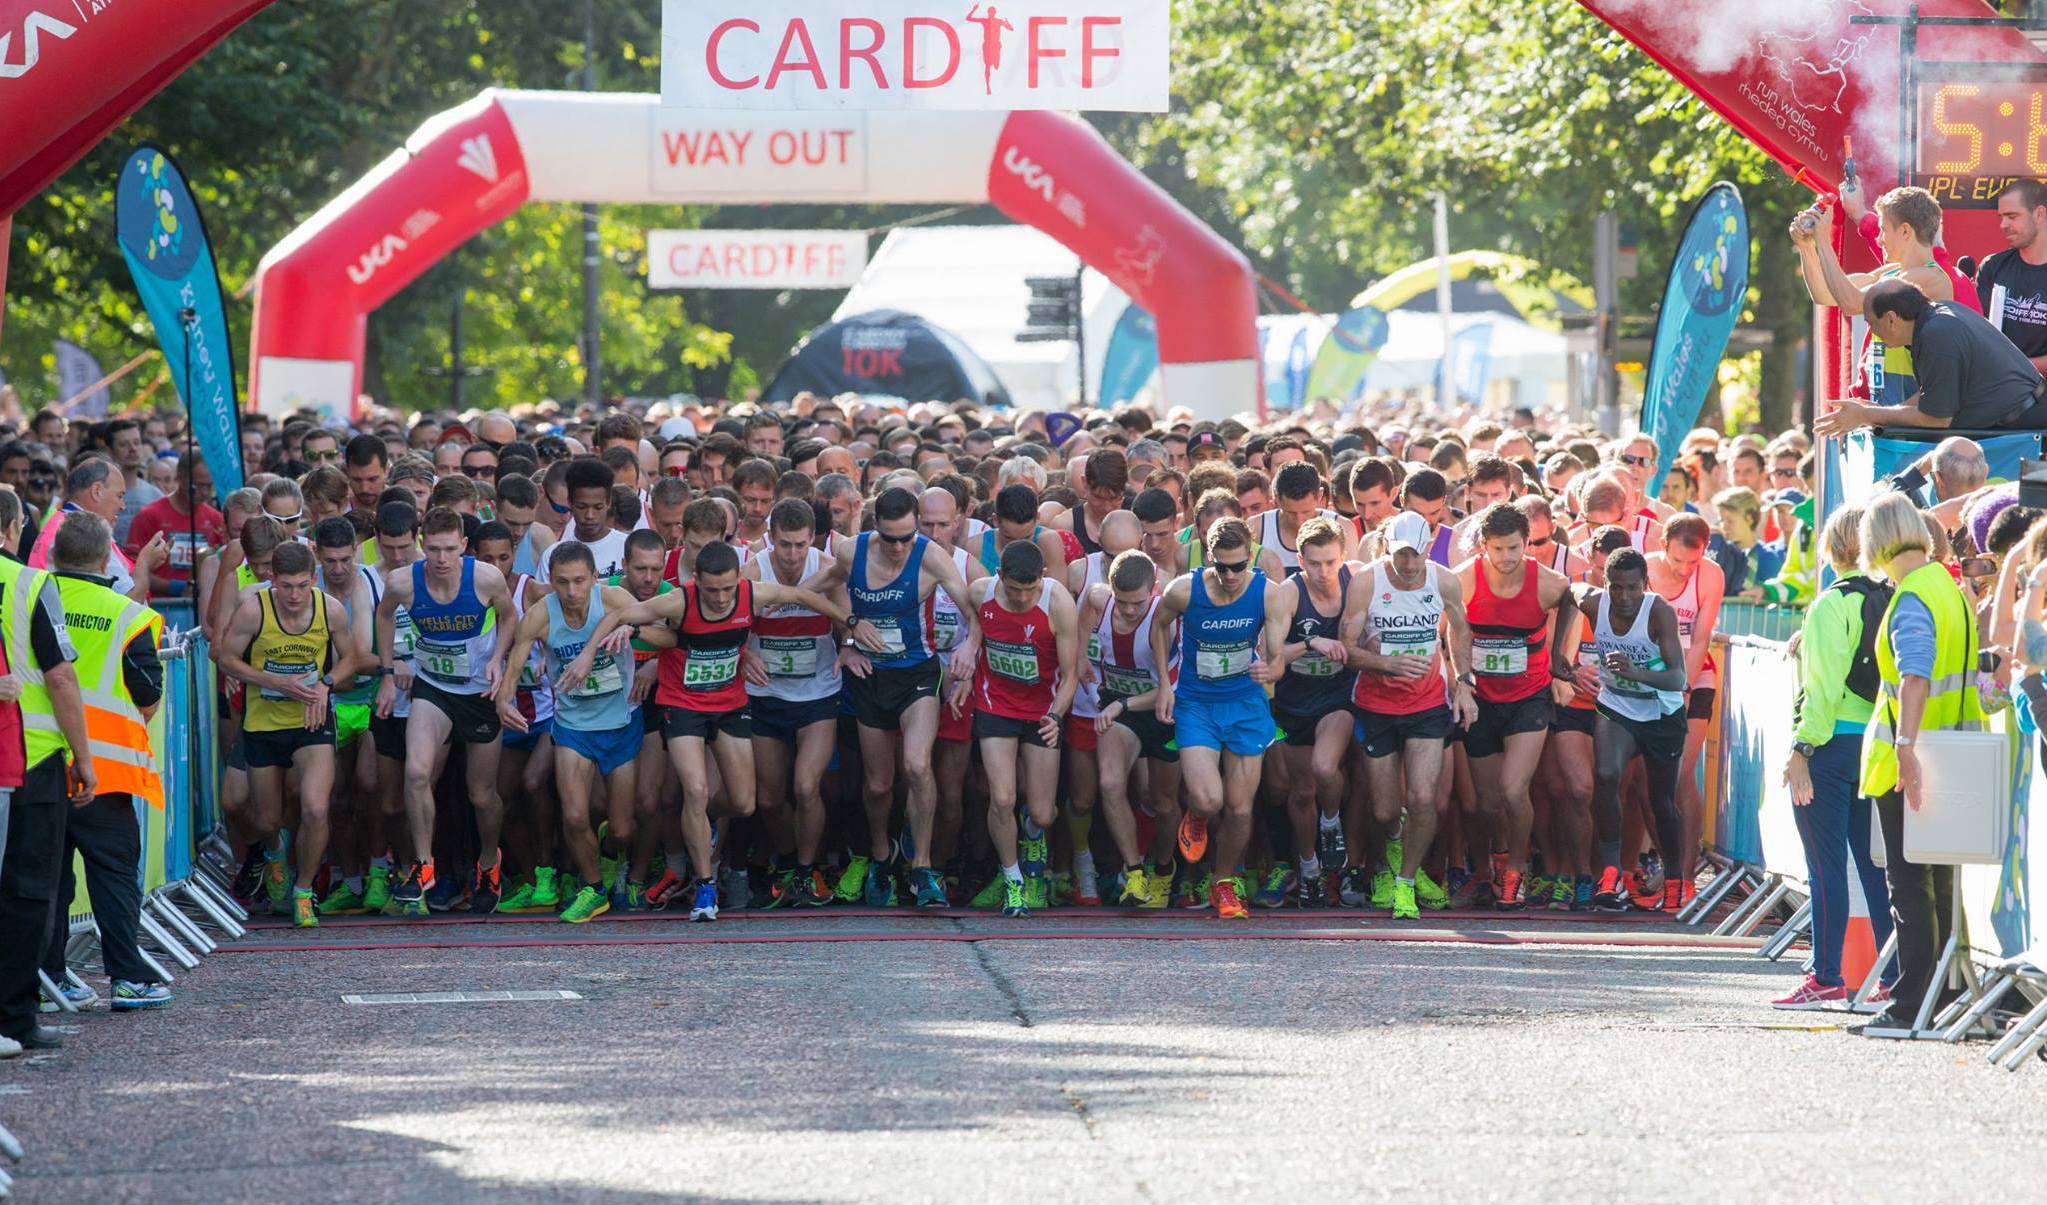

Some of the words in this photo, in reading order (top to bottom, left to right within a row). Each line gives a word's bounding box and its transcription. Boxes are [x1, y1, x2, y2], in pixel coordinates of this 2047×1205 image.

[1756, 81, 1779, 105] run
[1781, 99, 1817, 137] wales
[1738, 83, 1787, 130] rhedeg
[1787, 124, 1829, 161] cymru
[662, 128, 753, 166] WAY
[768, 128, 855, 166] OUT
[842, 345, 904, 378] 10K
[1662, 332, 1694, 409] Wales
[854, 586, 905, 603] CARDIFF
[64, 612, 112, 632] DIRECTOR
[454, 613, 480, 623] CITY
[1201, 618, 1254, 630] CARDIFF
[1374, 613, 1440, 628] ENGLAND
[428, 656, 454, 674] 18
[781, 655, 793, 673] 3
[988, 650, 1037, 677] 5602
[1218, 657, 1229, 674] 1
[1307, 661, 1332, 675] 15
[1486, 654, 1510, 671] 81
[586, 676, 600, 693] 4
